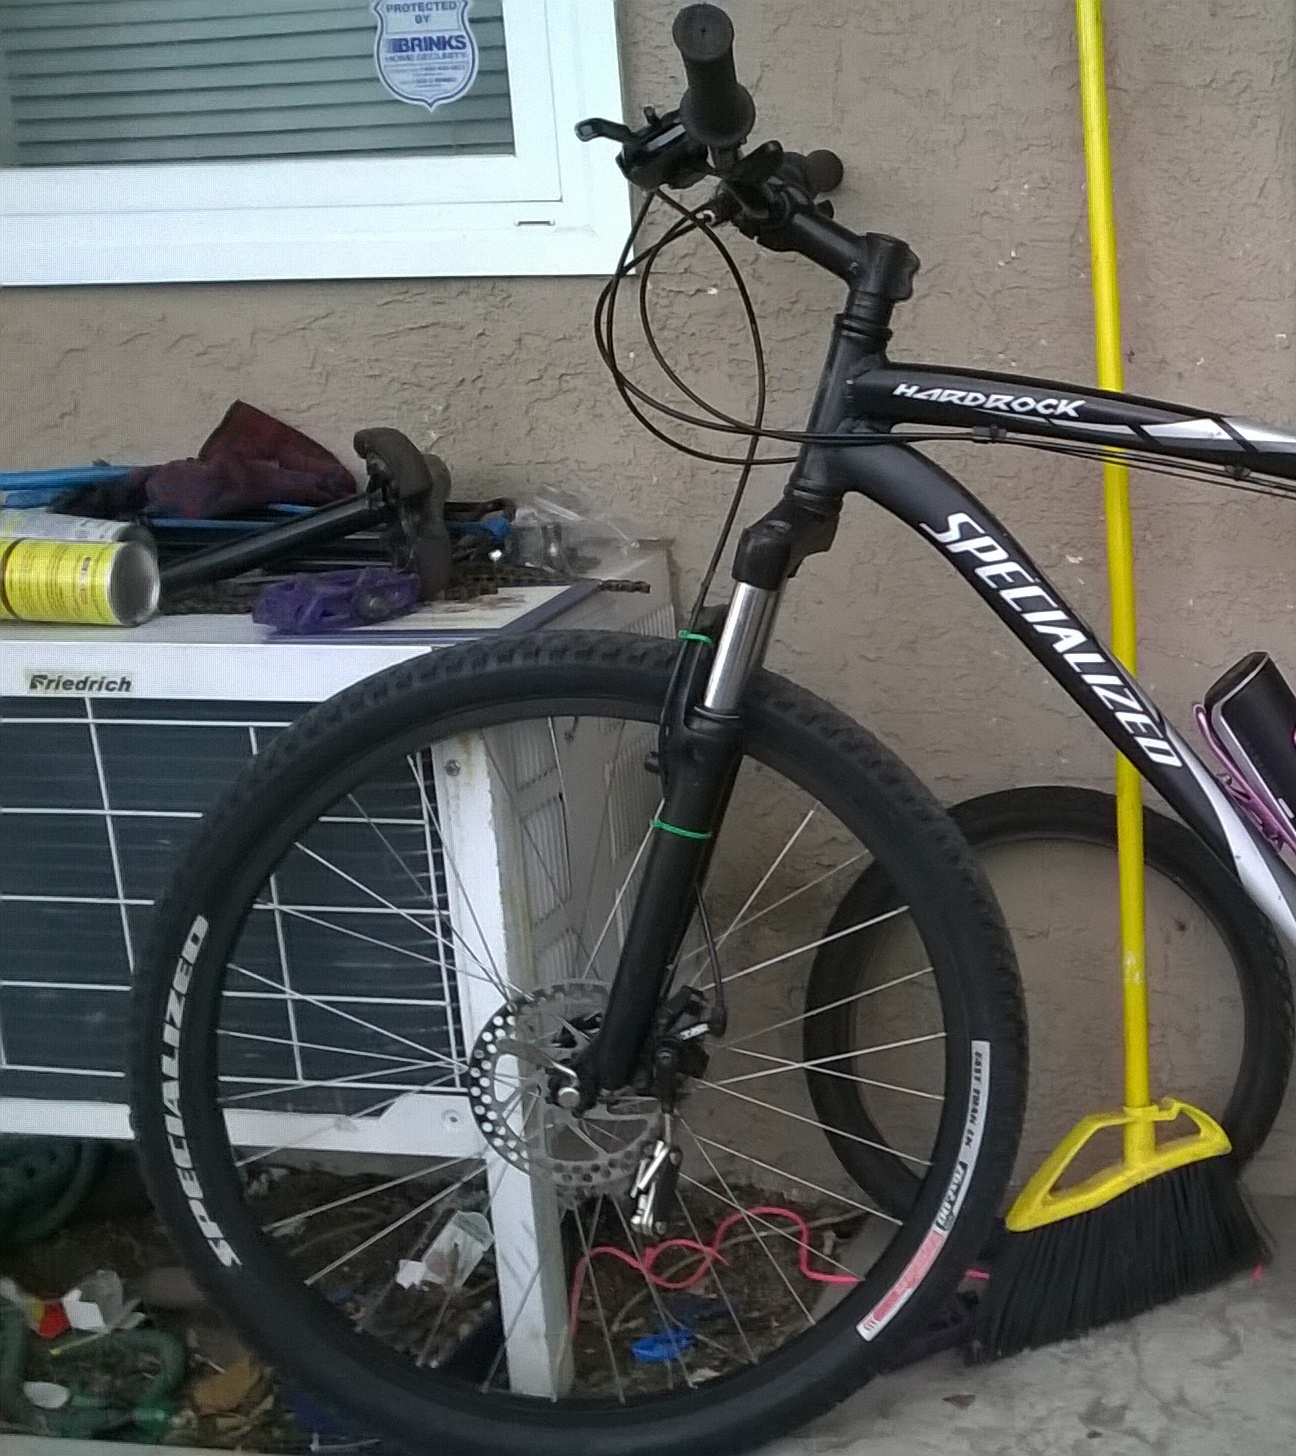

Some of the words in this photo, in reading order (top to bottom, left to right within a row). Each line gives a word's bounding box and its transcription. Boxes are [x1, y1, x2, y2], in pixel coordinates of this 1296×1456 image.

[385, 2, 457, 13] PROTECTED
[414, 15, 430, 24] BY
[391, 35, 467, 53] BRINKS
[893, 383, 1087, 418] HARDROCK
[919, 513, 1183, 768] SPECIALIZED
[29, 675, 133, 693] Friedrich
[161, 914, 242, 1267] SPECIALIZED
